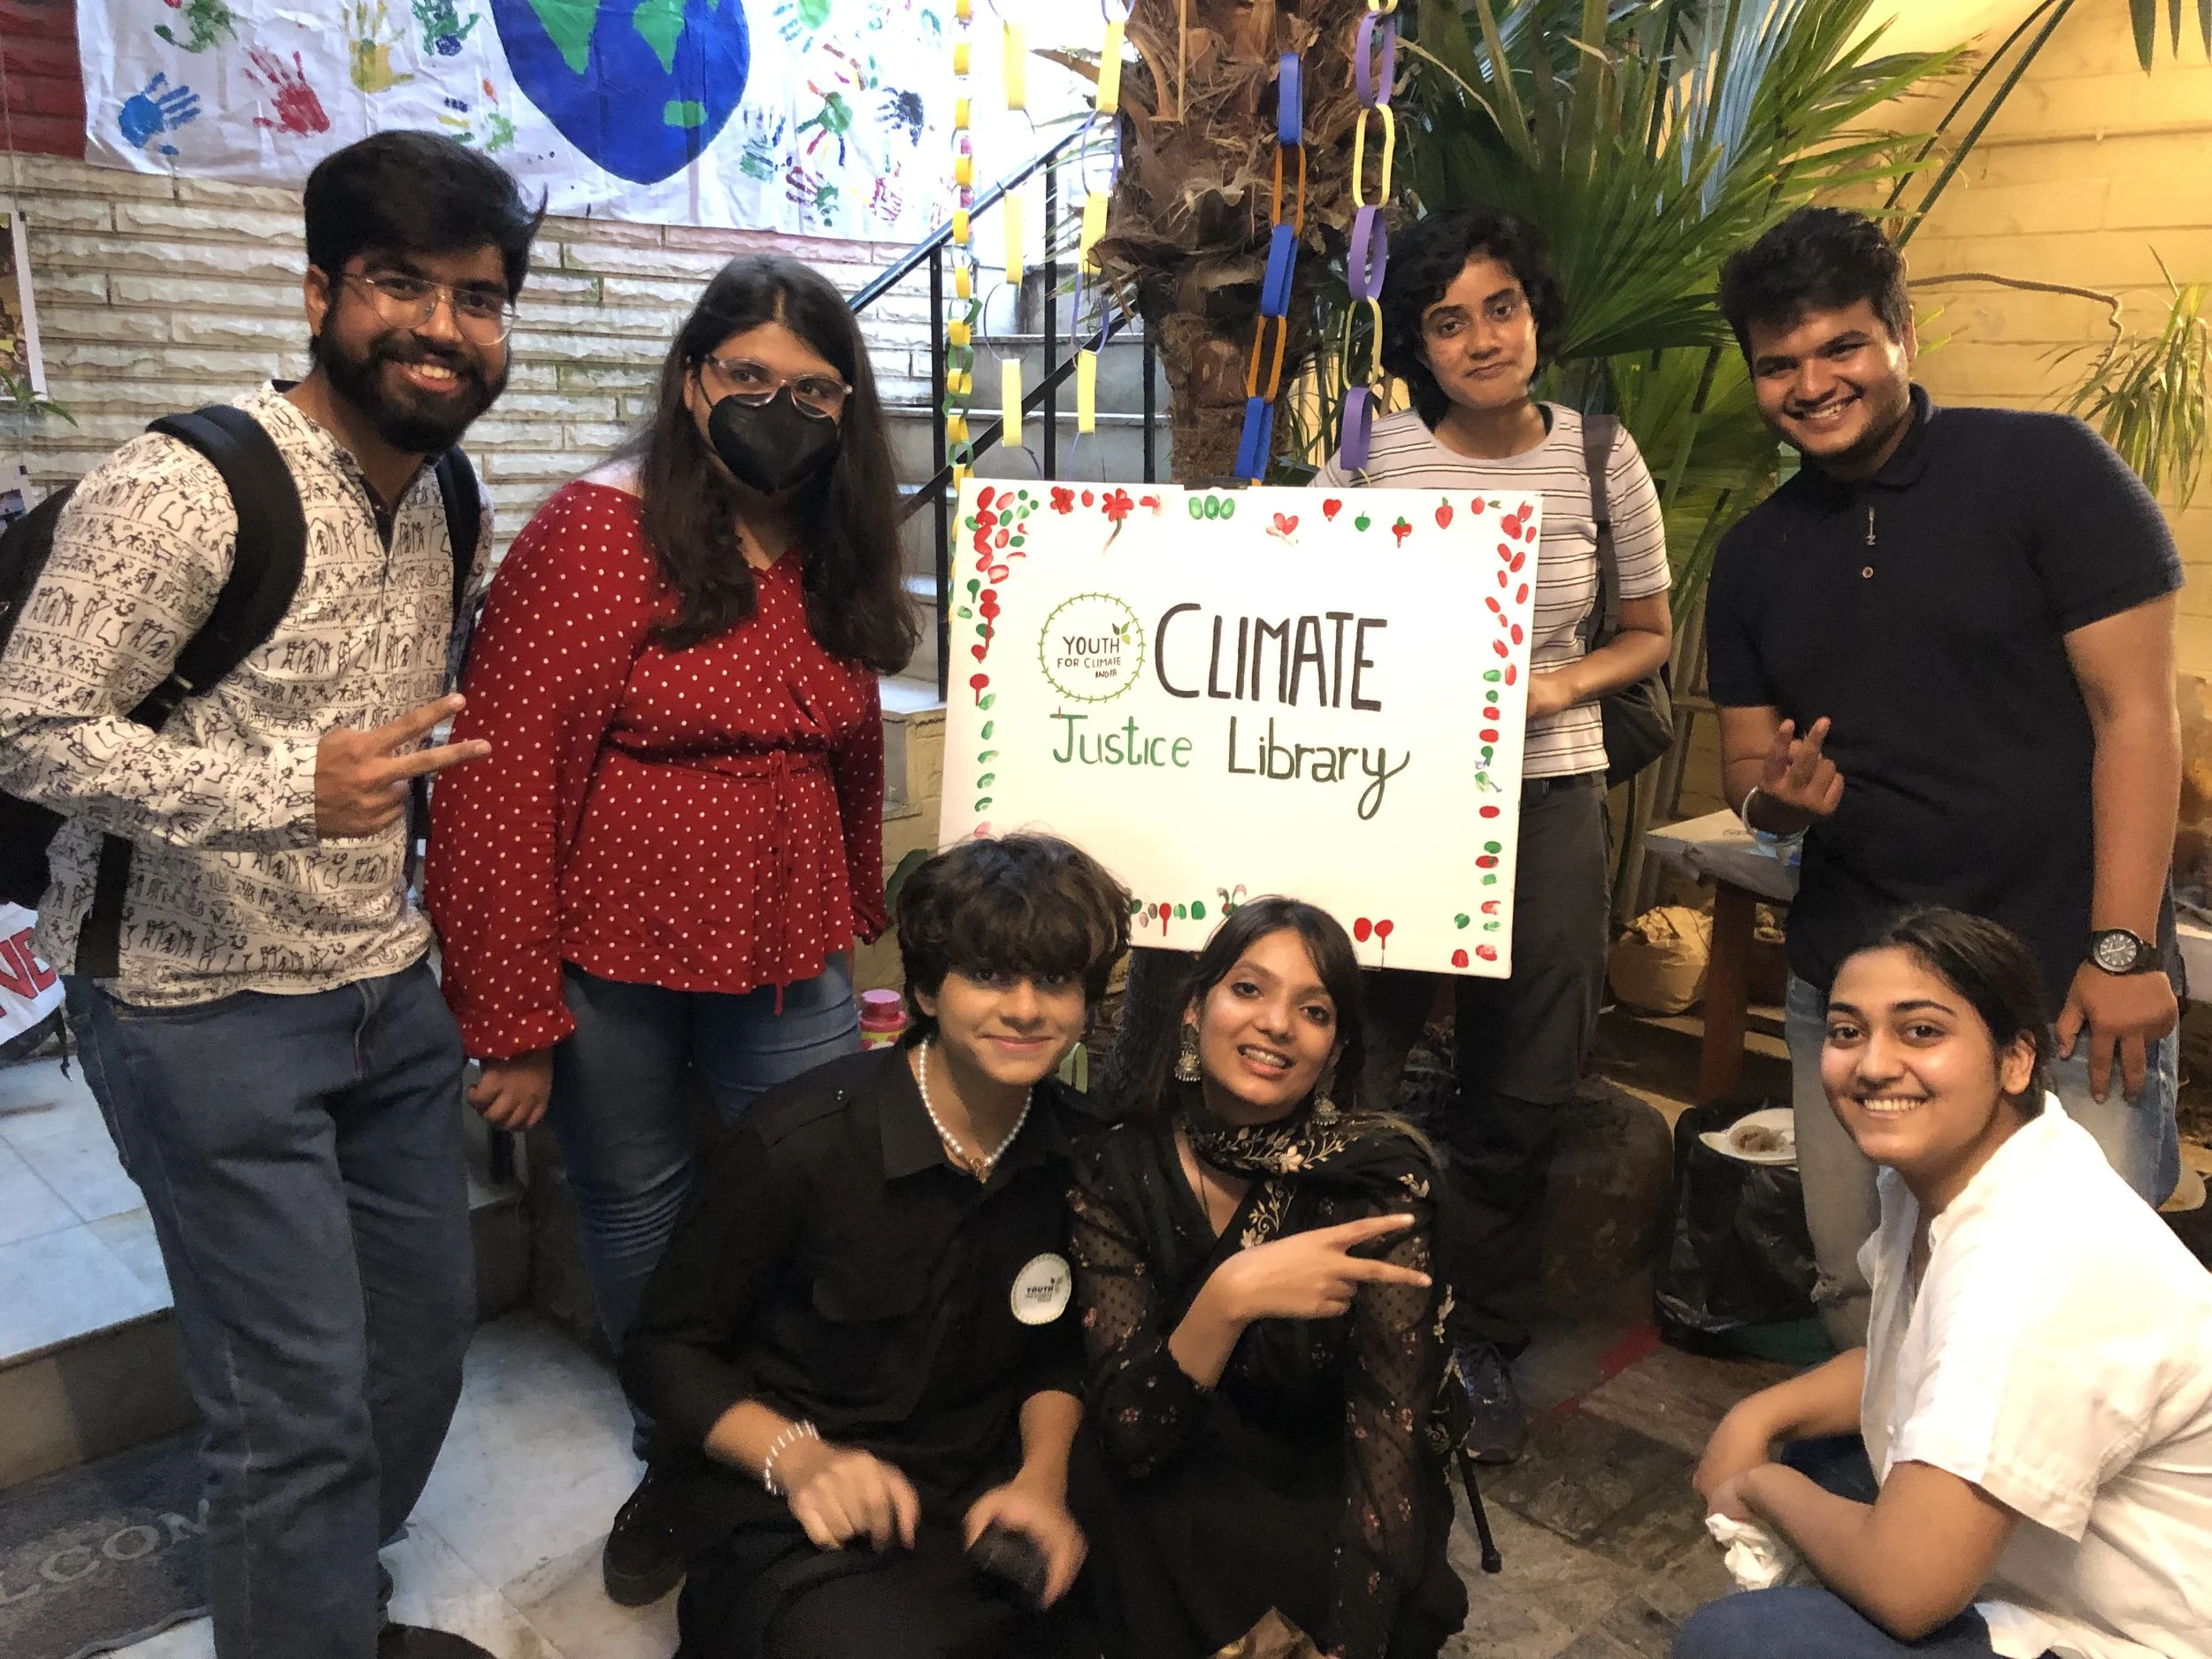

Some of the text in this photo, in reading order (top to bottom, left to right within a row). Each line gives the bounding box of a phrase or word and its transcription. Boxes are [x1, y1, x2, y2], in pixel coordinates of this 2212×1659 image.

[1056, 657, 1122, 669] FOR CLIMATE
[1063, 635, 1120, 656] YOUTH
[1155, 603, 1387, 711] CLIMATE
[1050, 714, 1410, 820] Justice Library
